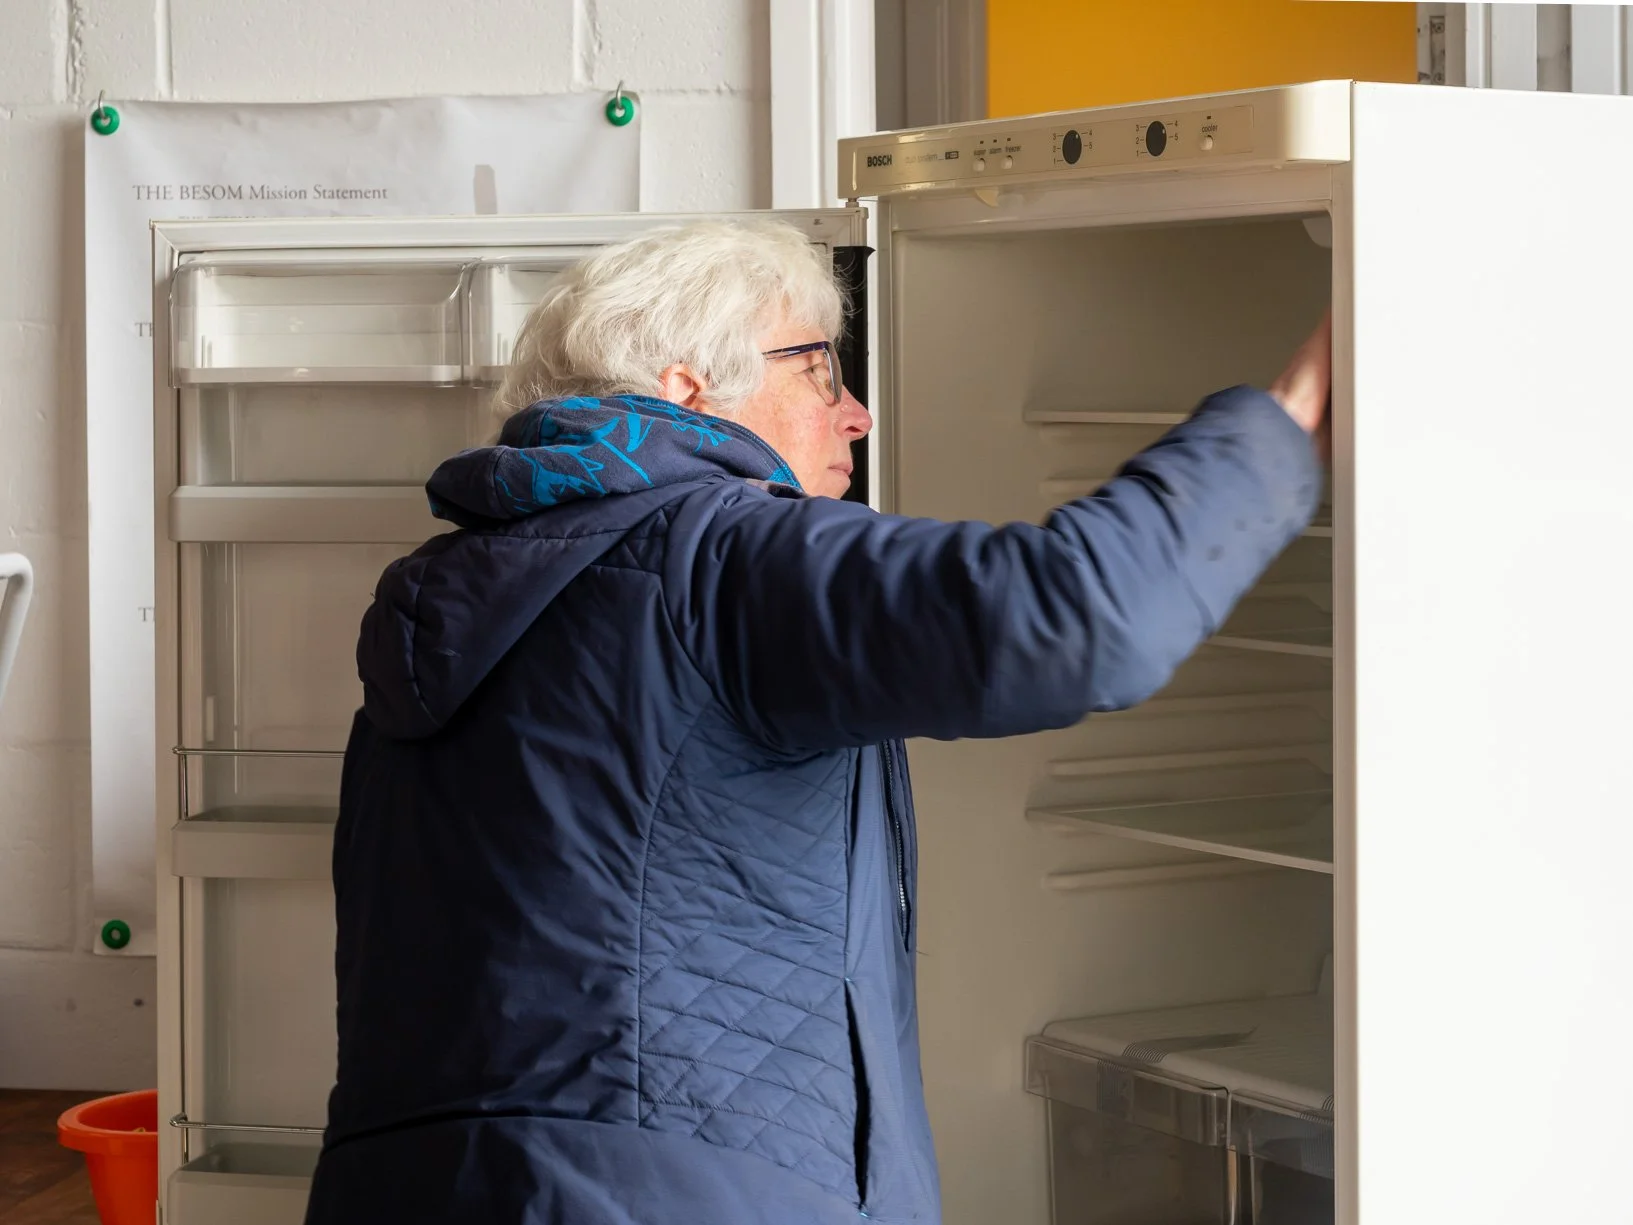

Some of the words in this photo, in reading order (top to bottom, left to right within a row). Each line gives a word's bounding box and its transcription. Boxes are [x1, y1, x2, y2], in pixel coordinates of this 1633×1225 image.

[1135, 124, 1140, 132] 3
[1201, 124, 1218, 132] cooler
[1135, 137, 1140, 145] 2
[867, 154, 892, 168] BOSCH
[132, 184, 174, 200] THE
[179, 184, 243, 200] BESOM
[249, 184, 307, 200] Mission
[312, 183, 388, 200] Statement
